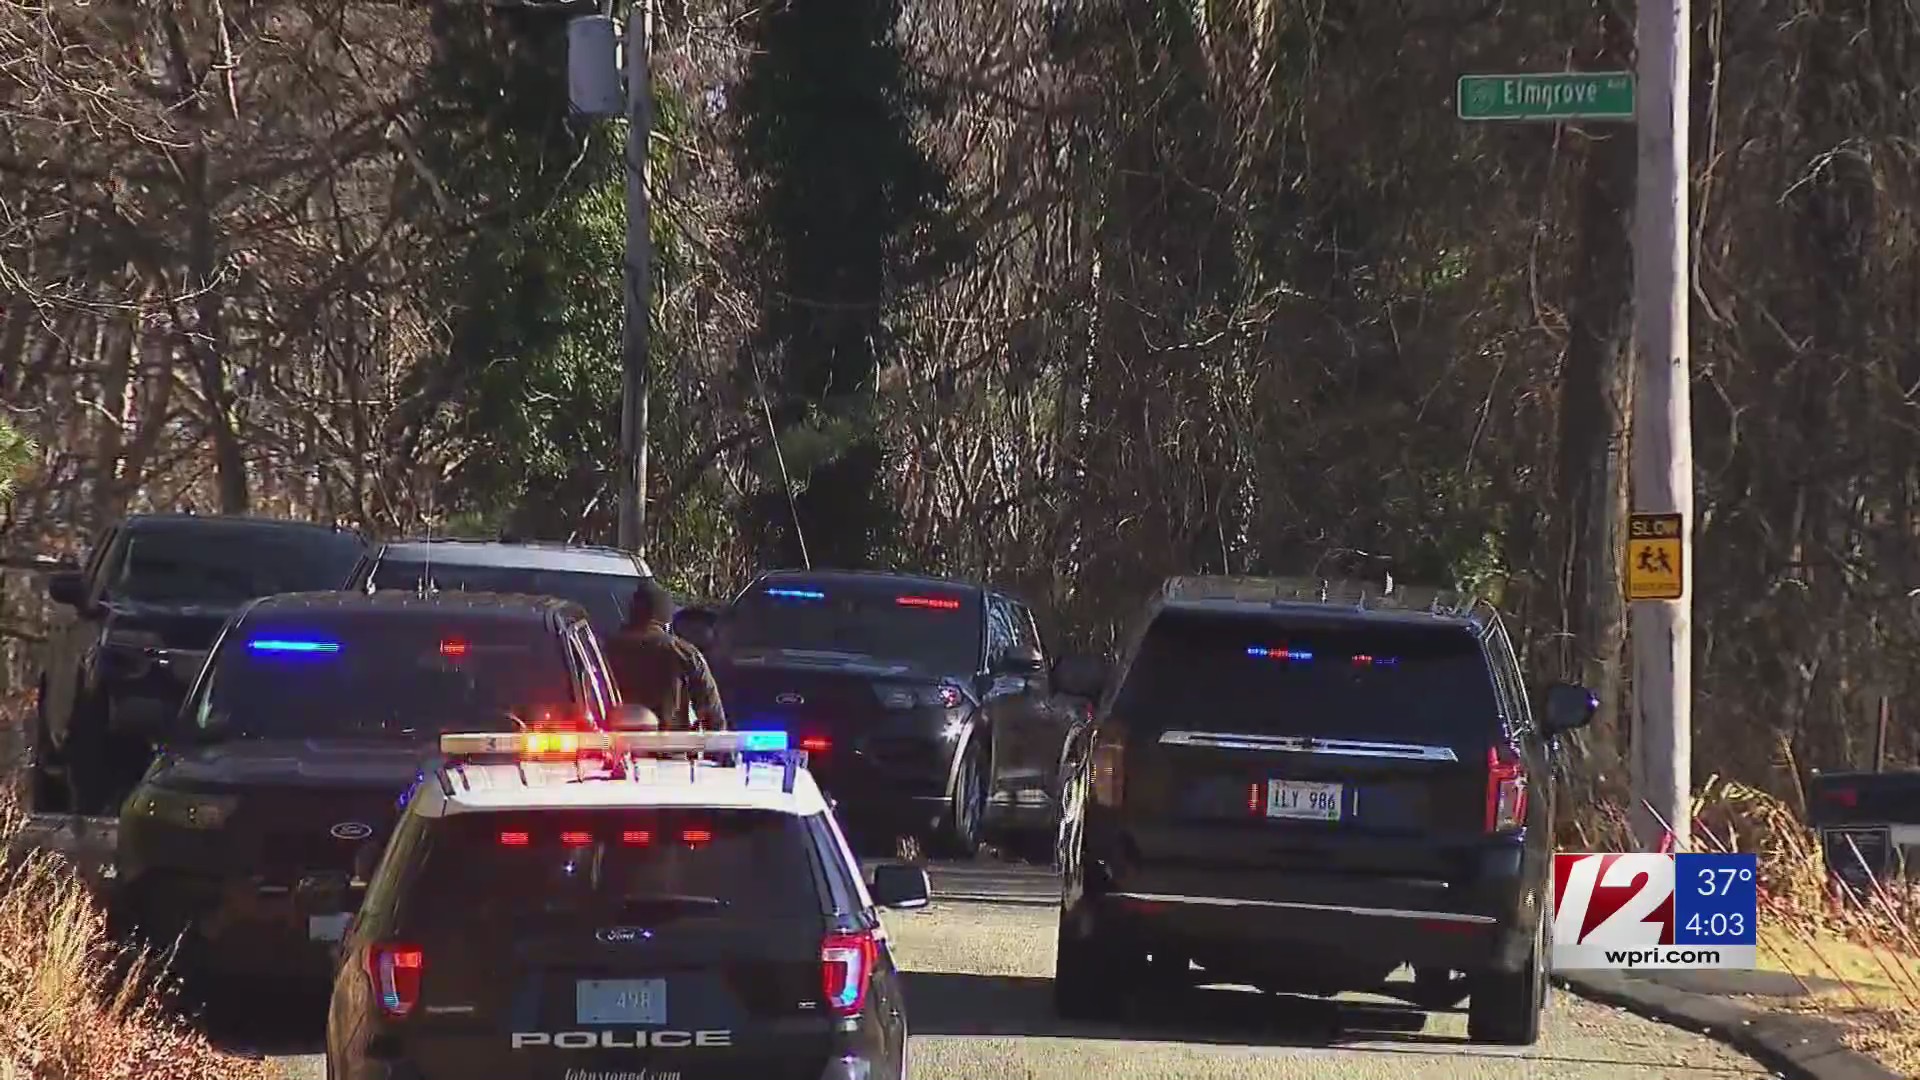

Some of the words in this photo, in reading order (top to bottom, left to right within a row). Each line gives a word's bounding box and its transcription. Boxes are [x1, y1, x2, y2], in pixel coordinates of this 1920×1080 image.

[1504, 80, 1597, 112] Elmgrove
[1632, 518, 1678, 536] SLOW
[1310, 792, 1336, 811] 986
[512, 1029, 732, 1049] POLICE
